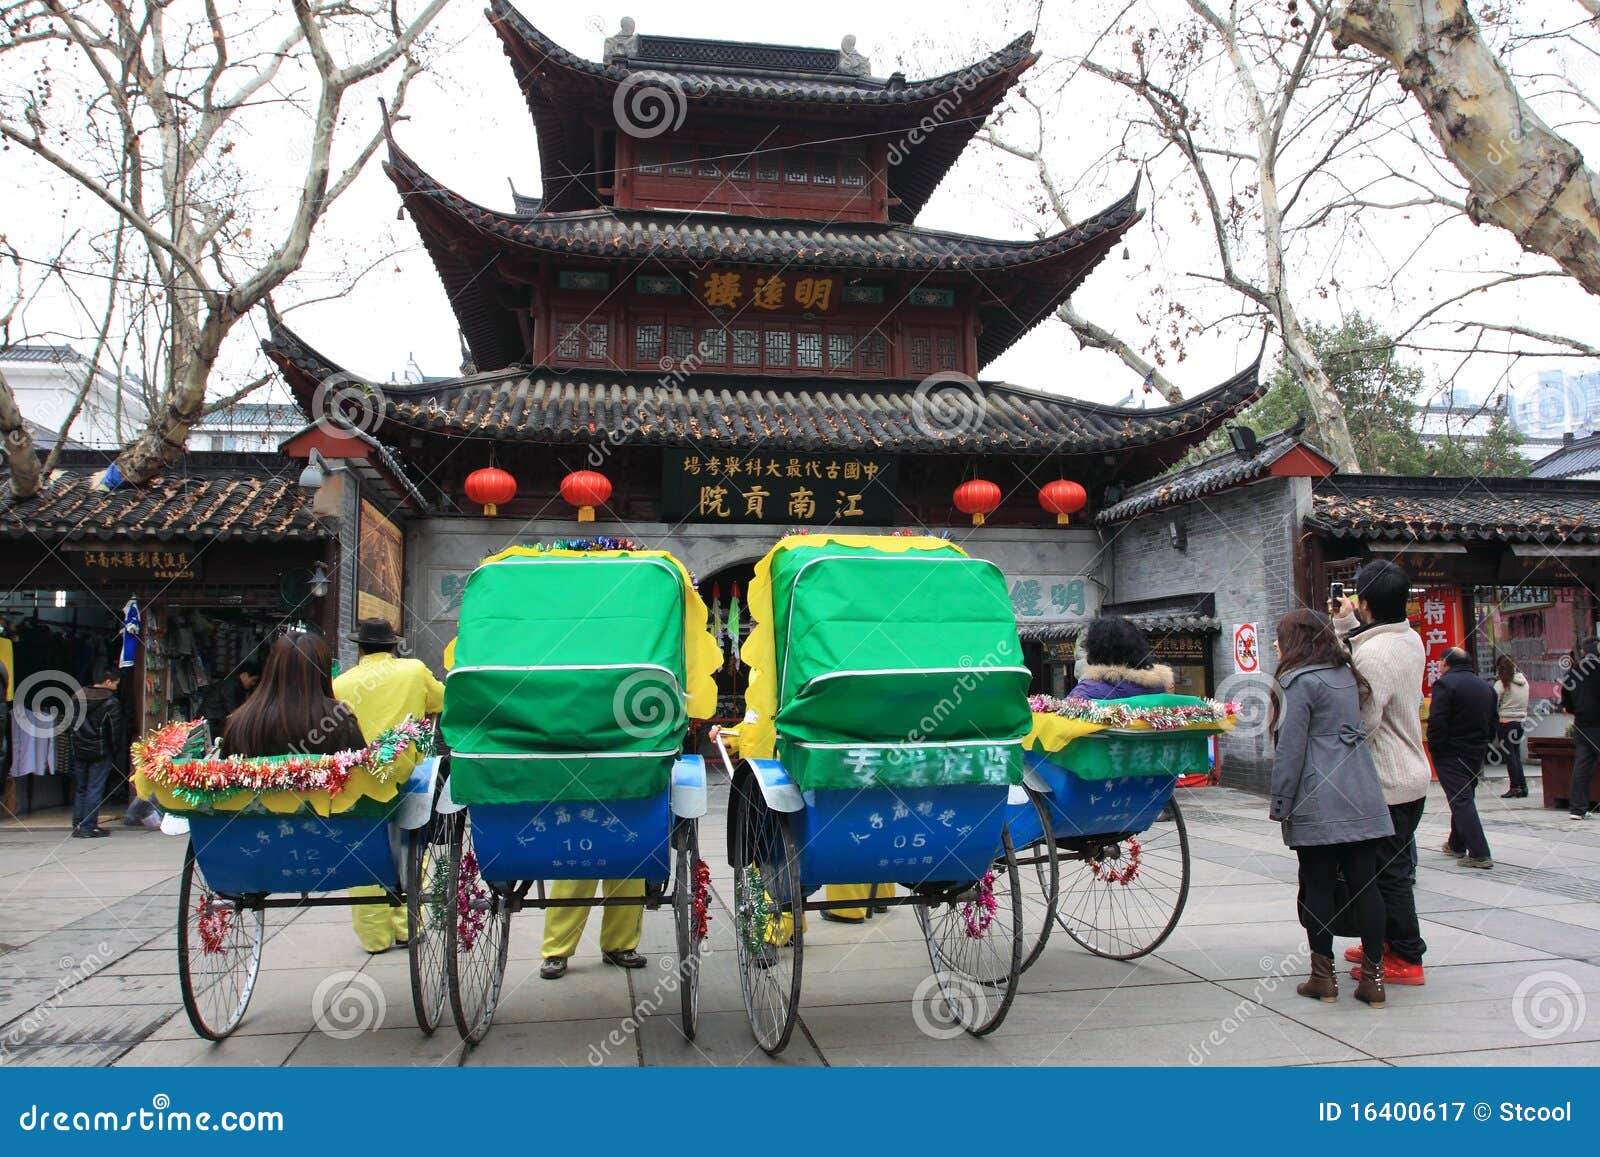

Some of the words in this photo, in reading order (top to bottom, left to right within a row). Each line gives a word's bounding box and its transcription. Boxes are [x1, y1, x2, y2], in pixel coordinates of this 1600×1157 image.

[683, 456, 879, 480] 中國古代最大科舉考場
[700, 485, 864, 519] 江南貢院
[562, 838, 593, 851] 10
[893, 833, 927, 848] 05
[290, 849, 321, 861] 12
